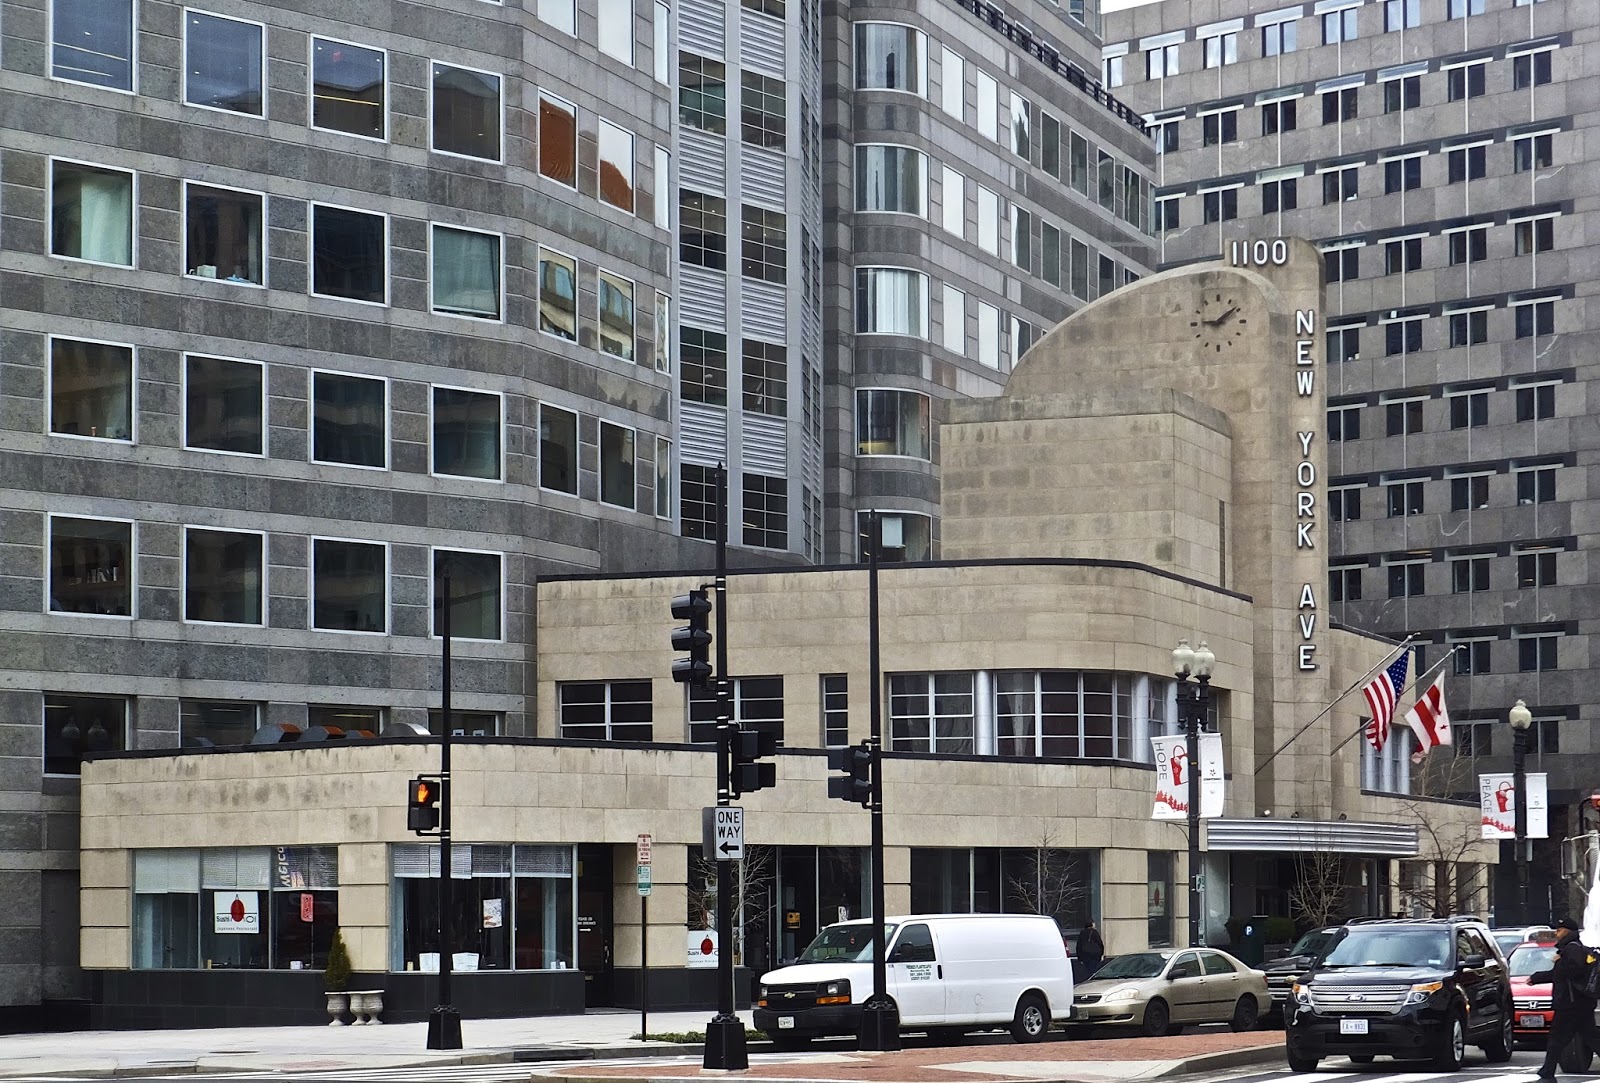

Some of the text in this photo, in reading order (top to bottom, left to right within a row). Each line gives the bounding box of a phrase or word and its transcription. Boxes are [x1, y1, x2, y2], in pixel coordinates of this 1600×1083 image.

[1231, 240, 1287, 266] 1100
[1296, 309, 1316, 670] NEW YORK AVE
[1154, 742, 1168, 780] HOPE
[1481, 778, 1493, 814] PEACE
[717, 811, 740, 824] ONE
[717, 826, 740, 839] WAY
[216, 915, 230, 923] Sushi
[1246, 925, 1253, 936] P
